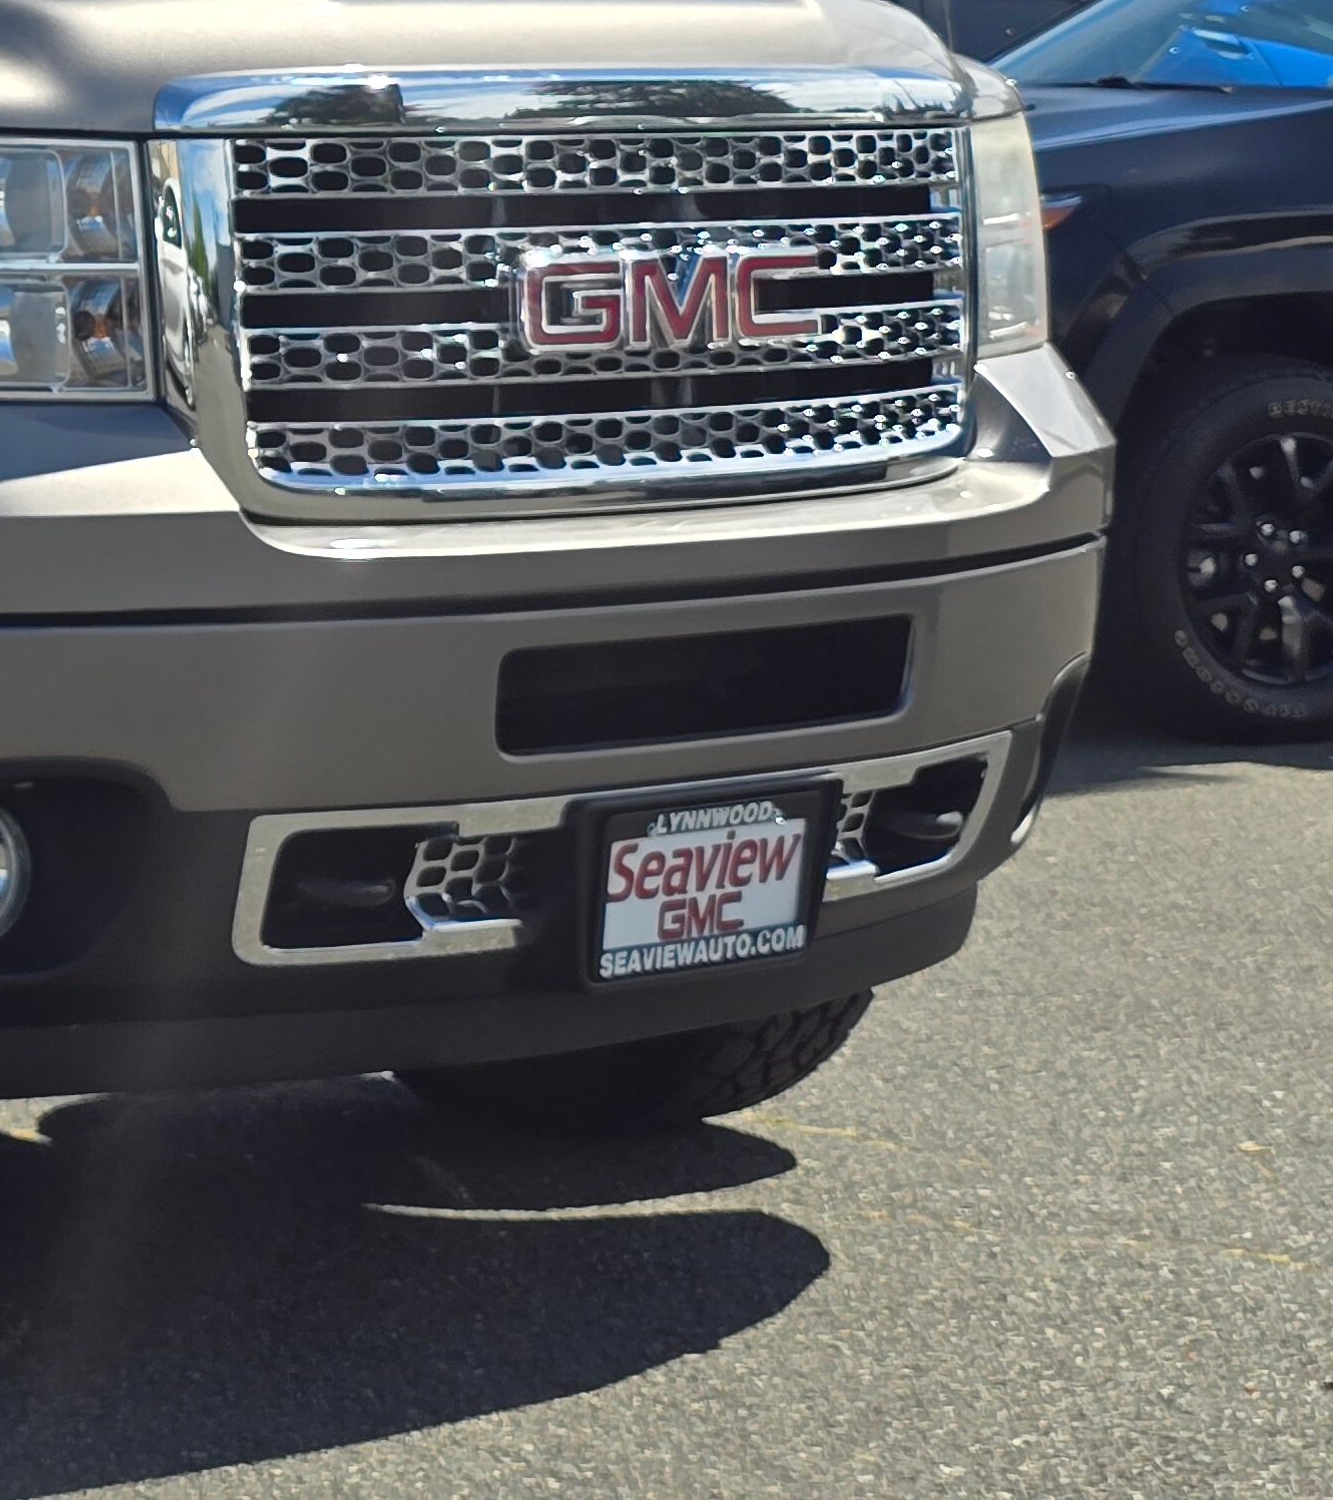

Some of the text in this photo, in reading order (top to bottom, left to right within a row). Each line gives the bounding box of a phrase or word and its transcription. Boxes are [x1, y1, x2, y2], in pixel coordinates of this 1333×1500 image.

[521, 247, 823, 352] GMC
[656, 801, 774, 834] LYNNWOOD
[607, 830, 801, 902] Seaview
[658, 891, 744, 941] GMC
[599, 925, 807, 979] SEAVIEWAUTO.COM
